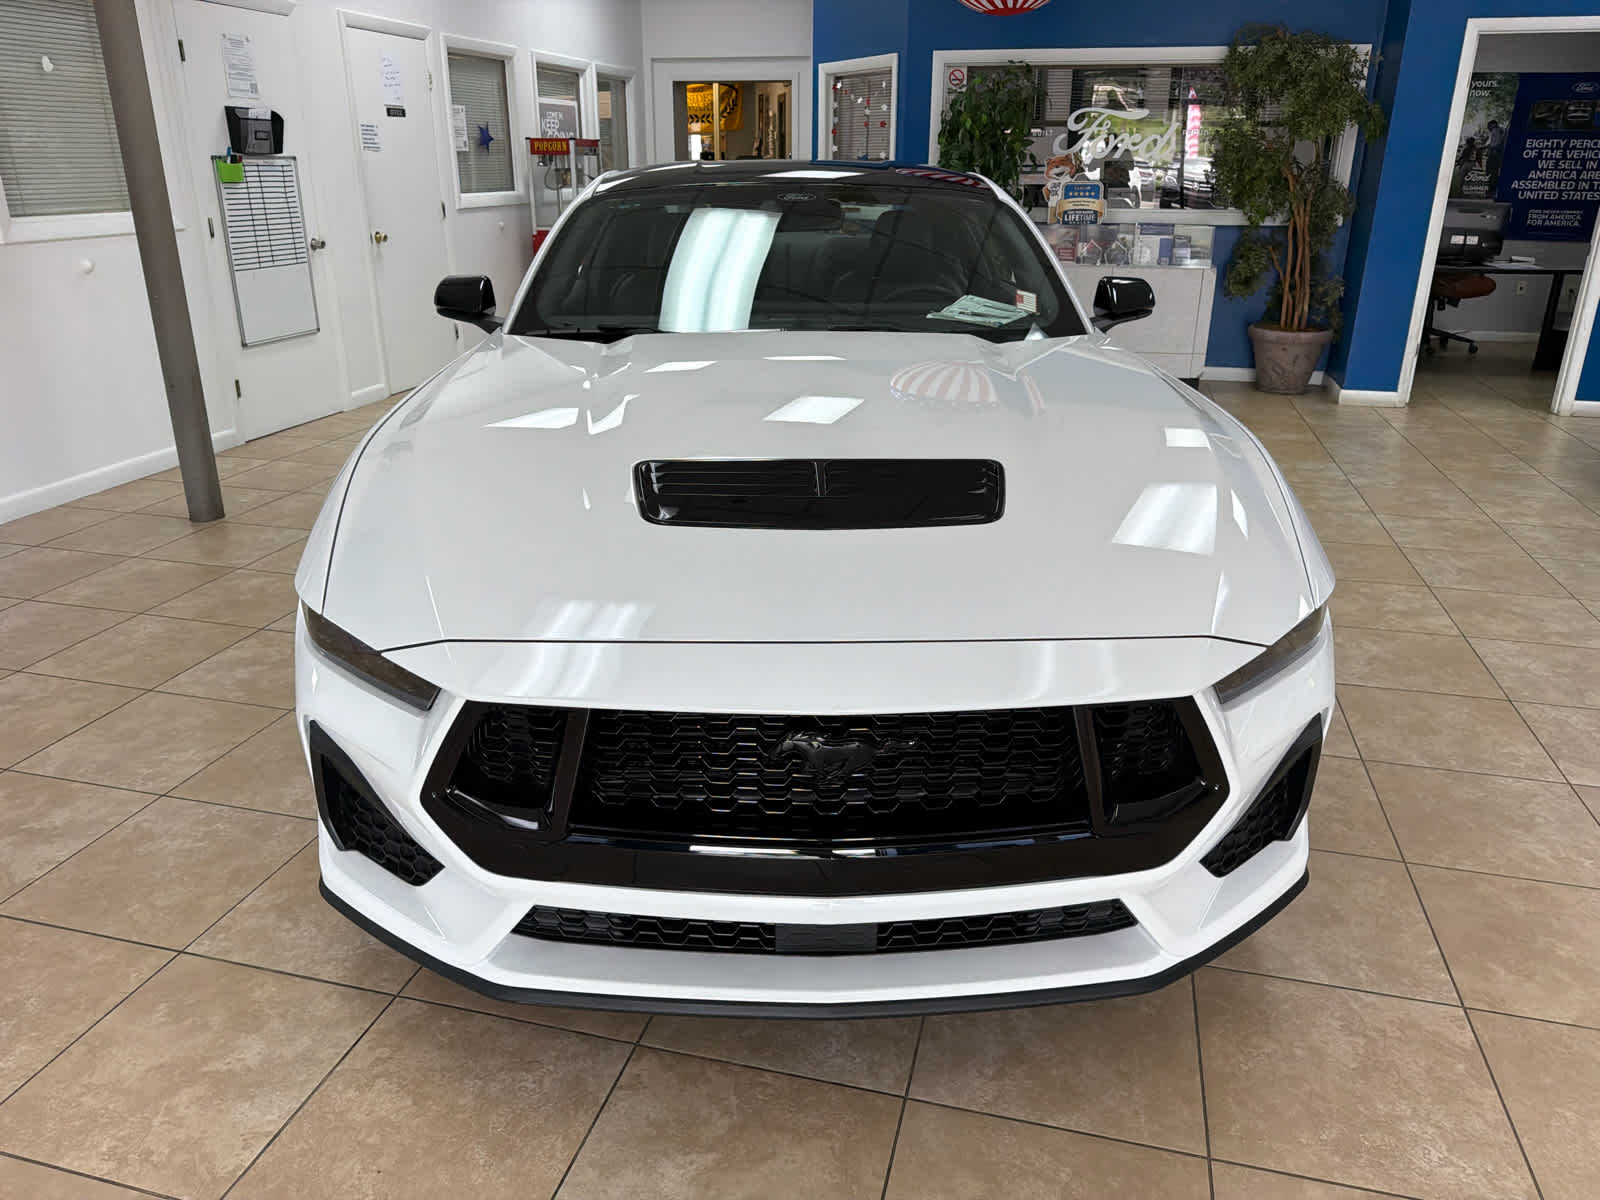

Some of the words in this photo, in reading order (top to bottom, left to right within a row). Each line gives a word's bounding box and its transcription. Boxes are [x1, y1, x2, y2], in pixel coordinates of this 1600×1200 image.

[1053, 107, 1181, 164] Ford
[534, 142, 567, 151] POPCORN
[1526, 138, 1567, 148] EIGHTY
[1569, 138, 1600, 149] PERC
[1522, 149, 1539, 159] OF
[1541, 149, 1563, 159] THE
[1566, 149, 1600, 159] VEHIC
[1537, 159, 1557, 169] WE
[1558, 160, 1583, 169] SELL
[1585, 160, 1599, 169] IN
[1527, 170, 1577, 179] AMERICA
[1578, 170, 1600, 180] ARE
[1511, 180, 1576, 190] ASSEMBLED
[1577, 181, 1591, 191] IN
[1592, 181, 1600, 191] T
[1517, 190, 1559, 200] UNITED
[1064, 213, 1097, 222] LIFETIME
